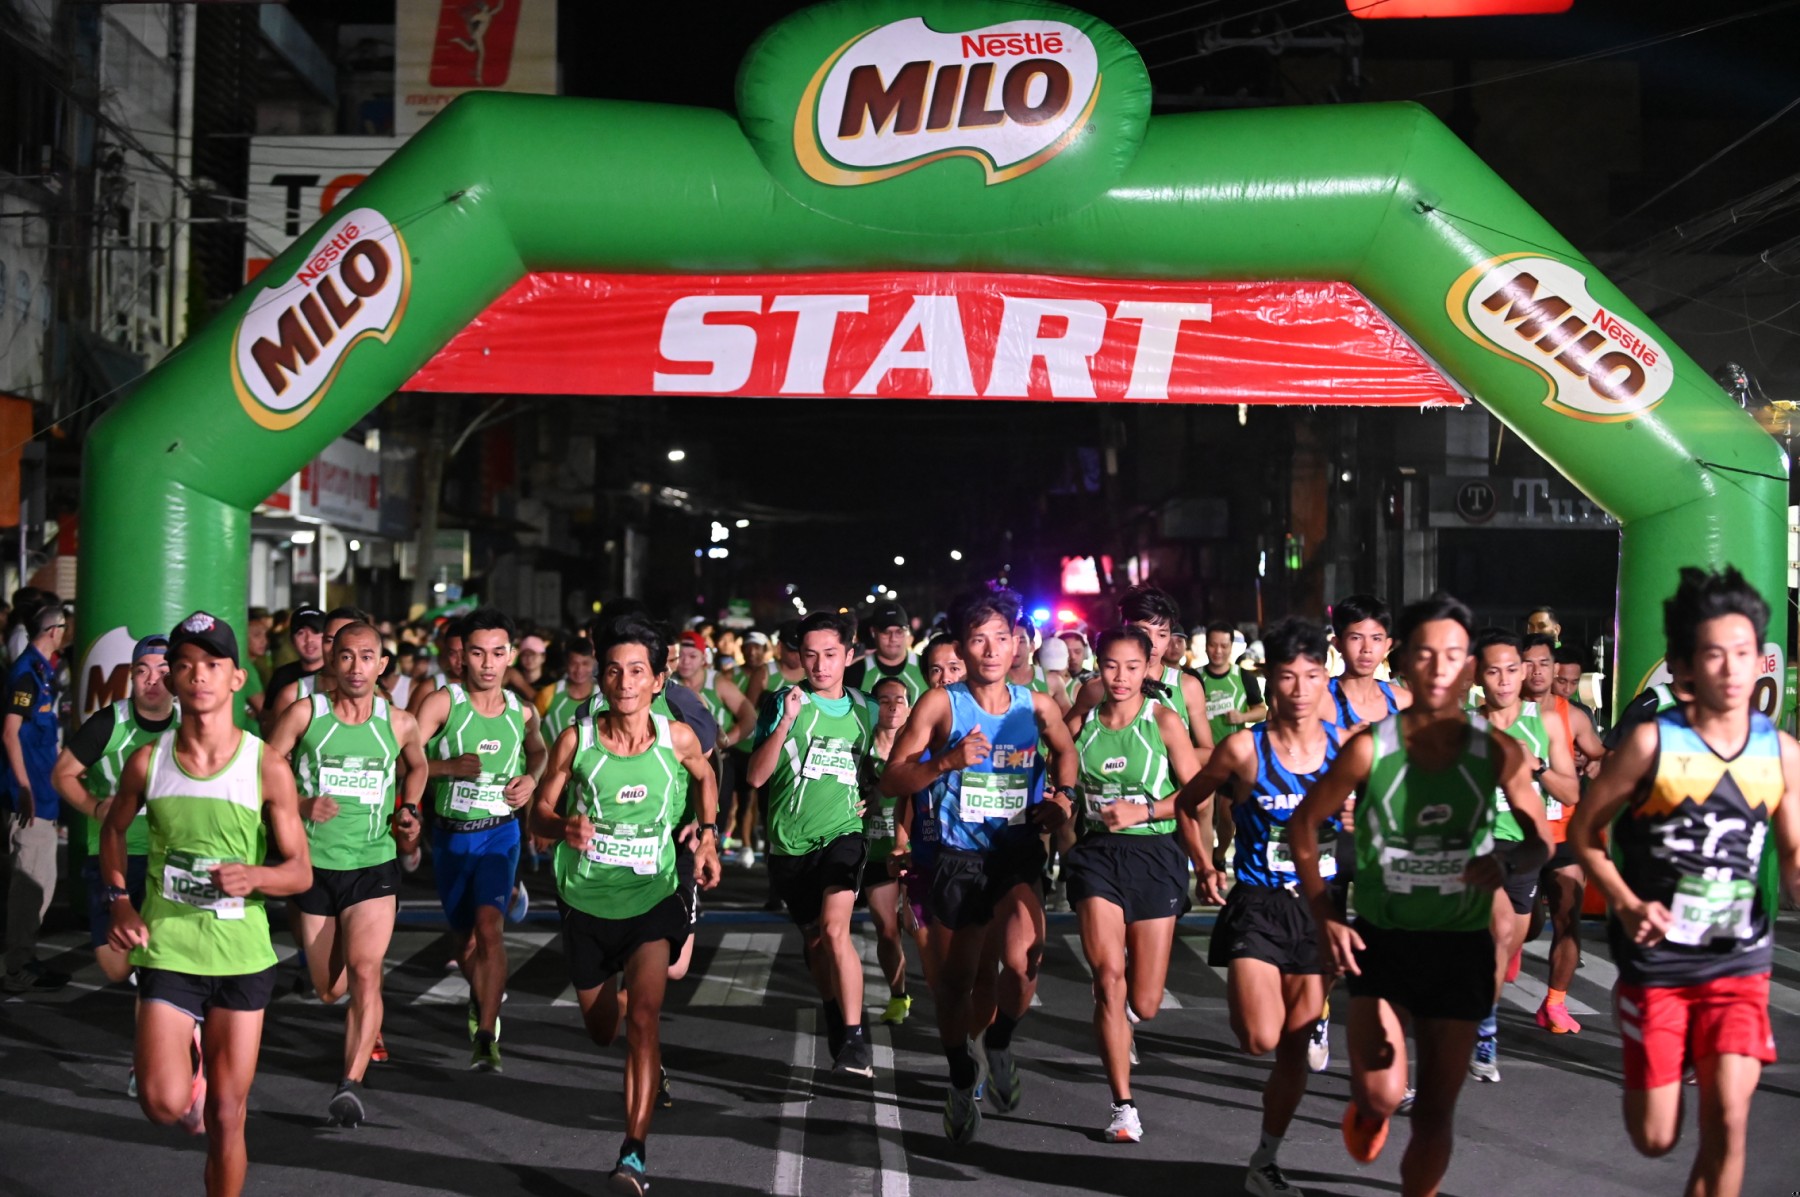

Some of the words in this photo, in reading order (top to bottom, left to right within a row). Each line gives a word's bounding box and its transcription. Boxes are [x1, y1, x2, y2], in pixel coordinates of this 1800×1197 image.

[837, 58, 1072, 139] MILO
[250, 239, 393, 397] MILO
[1481, 272, 1646, 404] MILO
[652, 294, 1212, 400] START
[479, 743, 499, 751] MILO
[810, 753, 855, 771] 102296
[1105, 761, 1125, 770] MILO
[324, 773, 378, 789] 102202
[620, 790, 645, 799] MILO
[965, 793, 1024, 810] 102850
